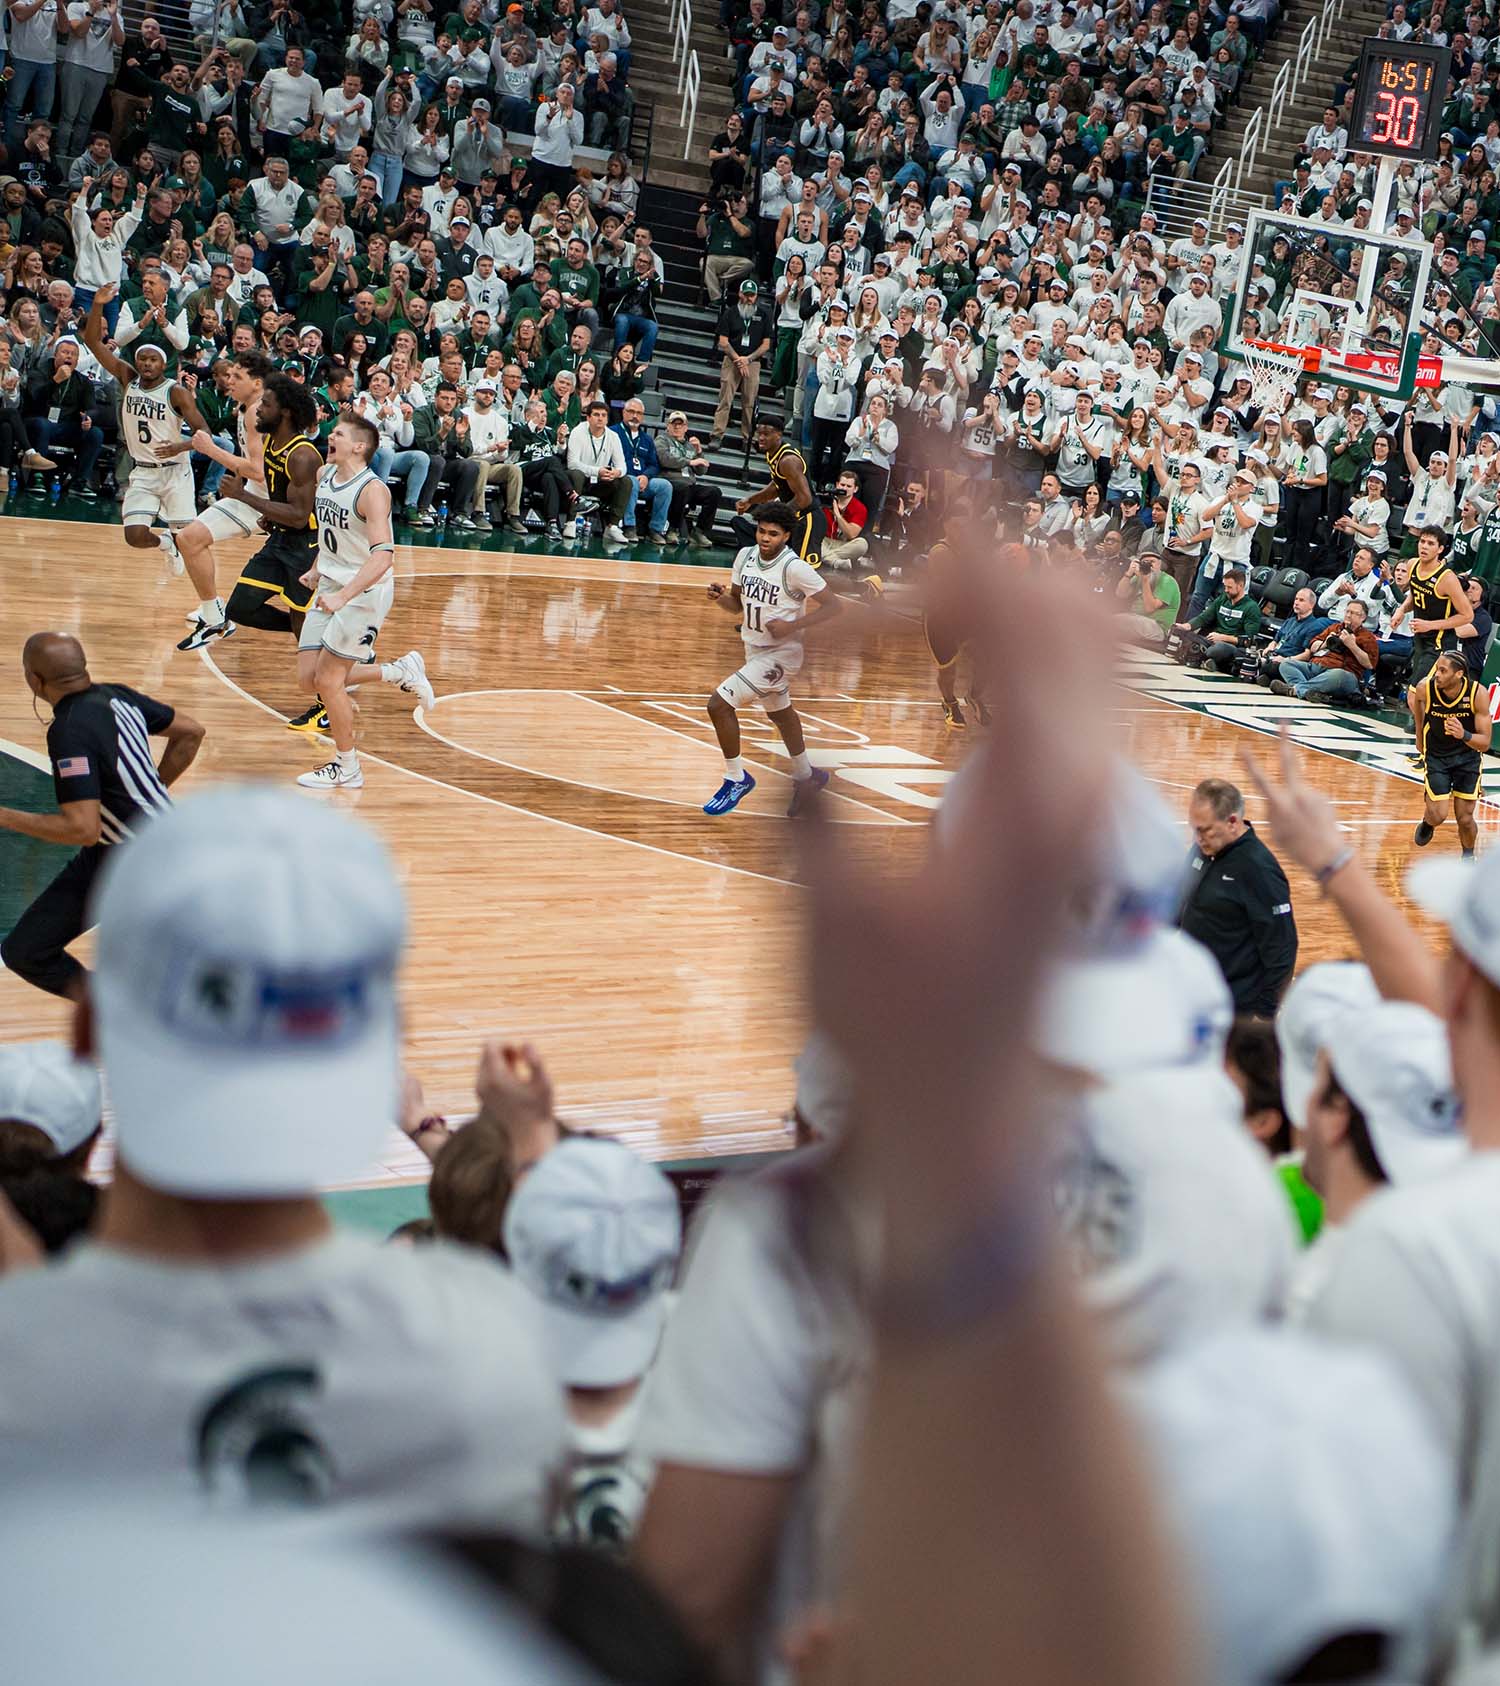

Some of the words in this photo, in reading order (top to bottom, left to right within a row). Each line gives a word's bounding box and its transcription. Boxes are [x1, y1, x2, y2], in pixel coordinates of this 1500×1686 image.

[1380, 62, 1432, 92] 16:51
[1371, 92, 1420, 147] 30
[1384, 361, 1400, 377] Sta
[1415, 367, 1436, 381] arm
[126, 396, 166, 421] STATE
[138, 421, 152, 443] 5
[974, 429, 992, 446] 55
[1074, 454, 1088, 466] 33
[268, 468, 276, 492] 7
[1130, 466, 1137, 479] 5
[324, 527, 338, 554] 0
[1454, 538, 1468, 555] 55
[742, 574, 781, 606] STATE
[1413, 590, 1426, 609] 21
[747, 603, 763, 633] 11
[1430, 710, 1470, 718] OREGON
